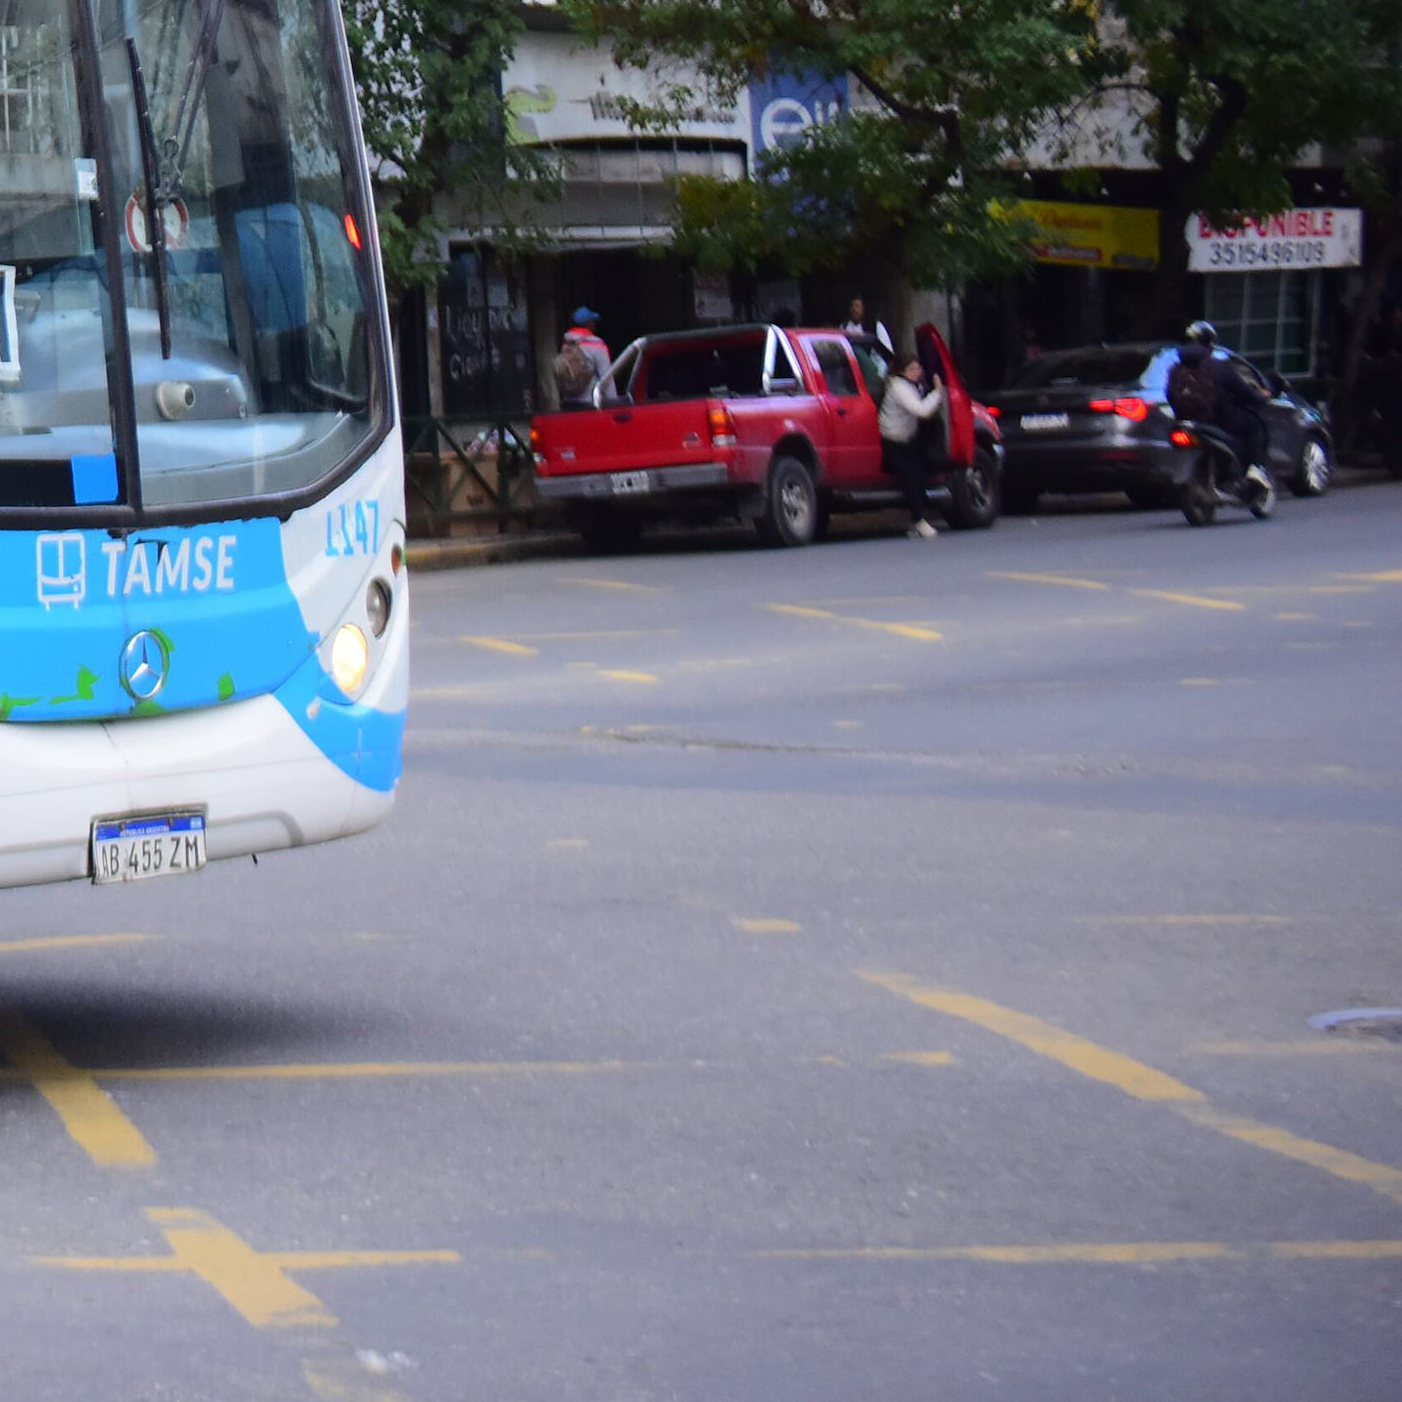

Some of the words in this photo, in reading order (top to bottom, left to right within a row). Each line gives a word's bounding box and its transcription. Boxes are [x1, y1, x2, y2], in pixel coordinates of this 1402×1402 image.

[1199, 210, 1334, 239] DPONIBLE
[102, 534, 238, 597] TAMSE
[101, 843, 120, 877] AB
[128, 838, 163, 873] 455
[170, 834, 200, 869] ZM
